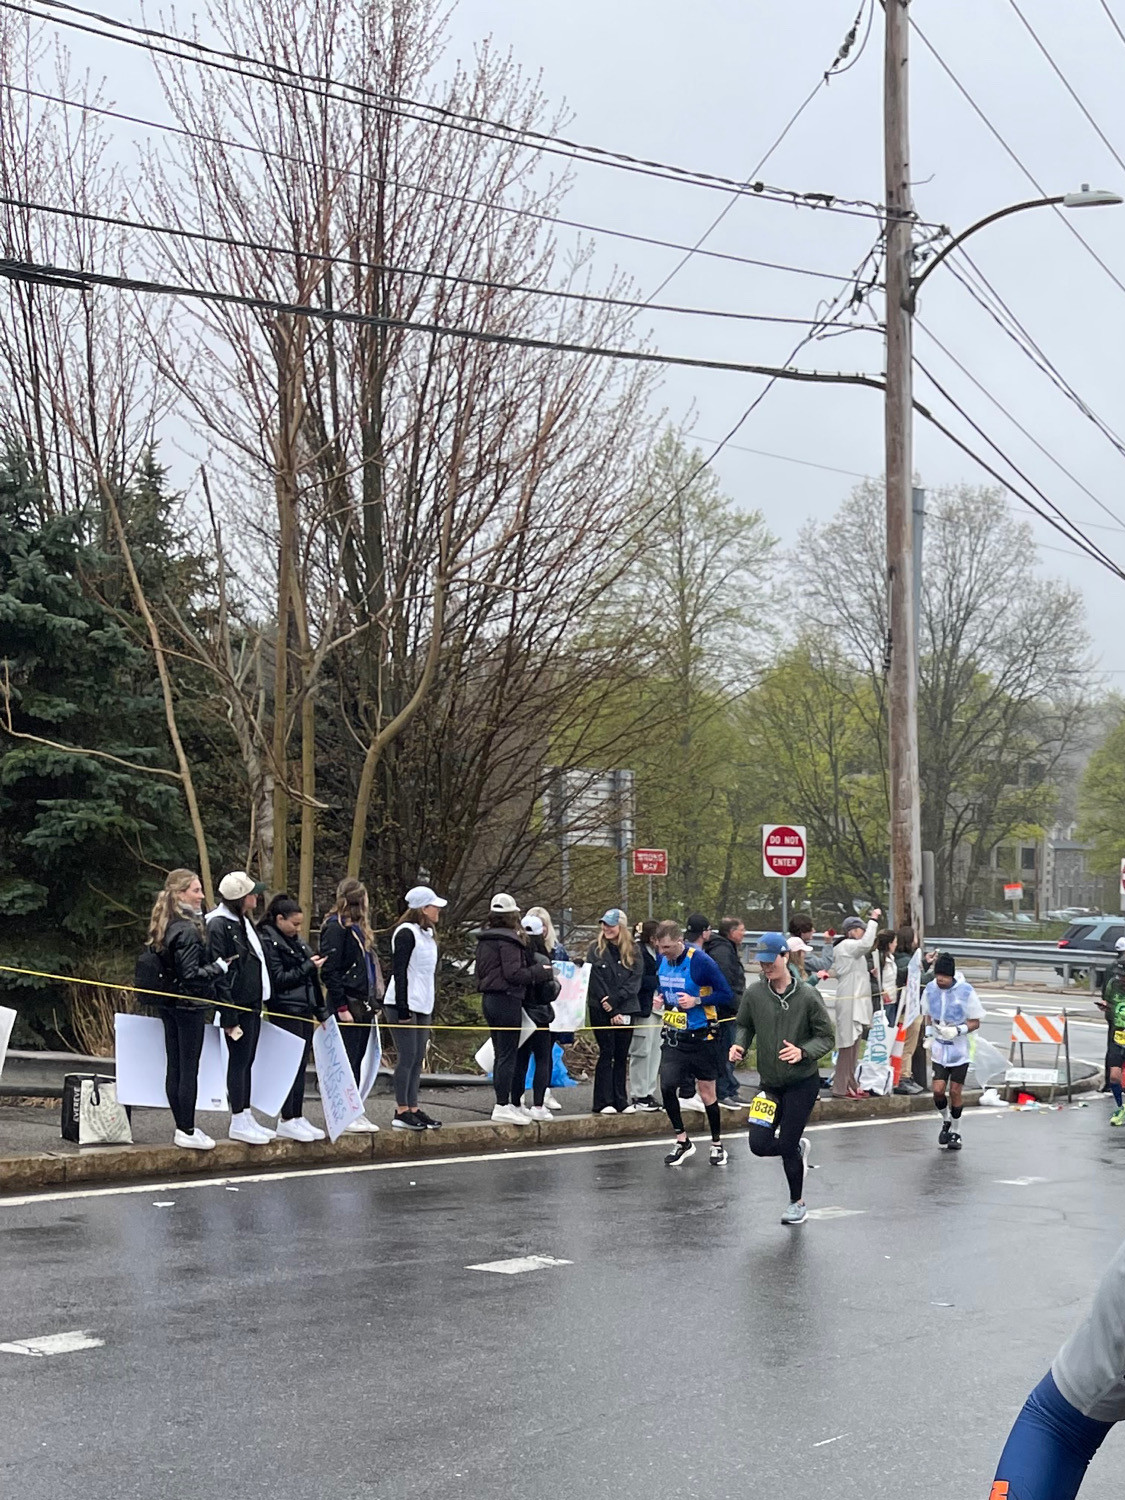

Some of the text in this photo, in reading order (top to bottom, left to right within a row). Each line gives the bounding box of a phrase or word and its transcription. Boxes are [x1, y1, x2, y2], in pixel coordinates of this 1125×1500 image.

[770, 835, 799, 845] DO NOT
[773, 858, 797, 867] ENTER
[73, 1086, 81, 1122] EVEREVE
